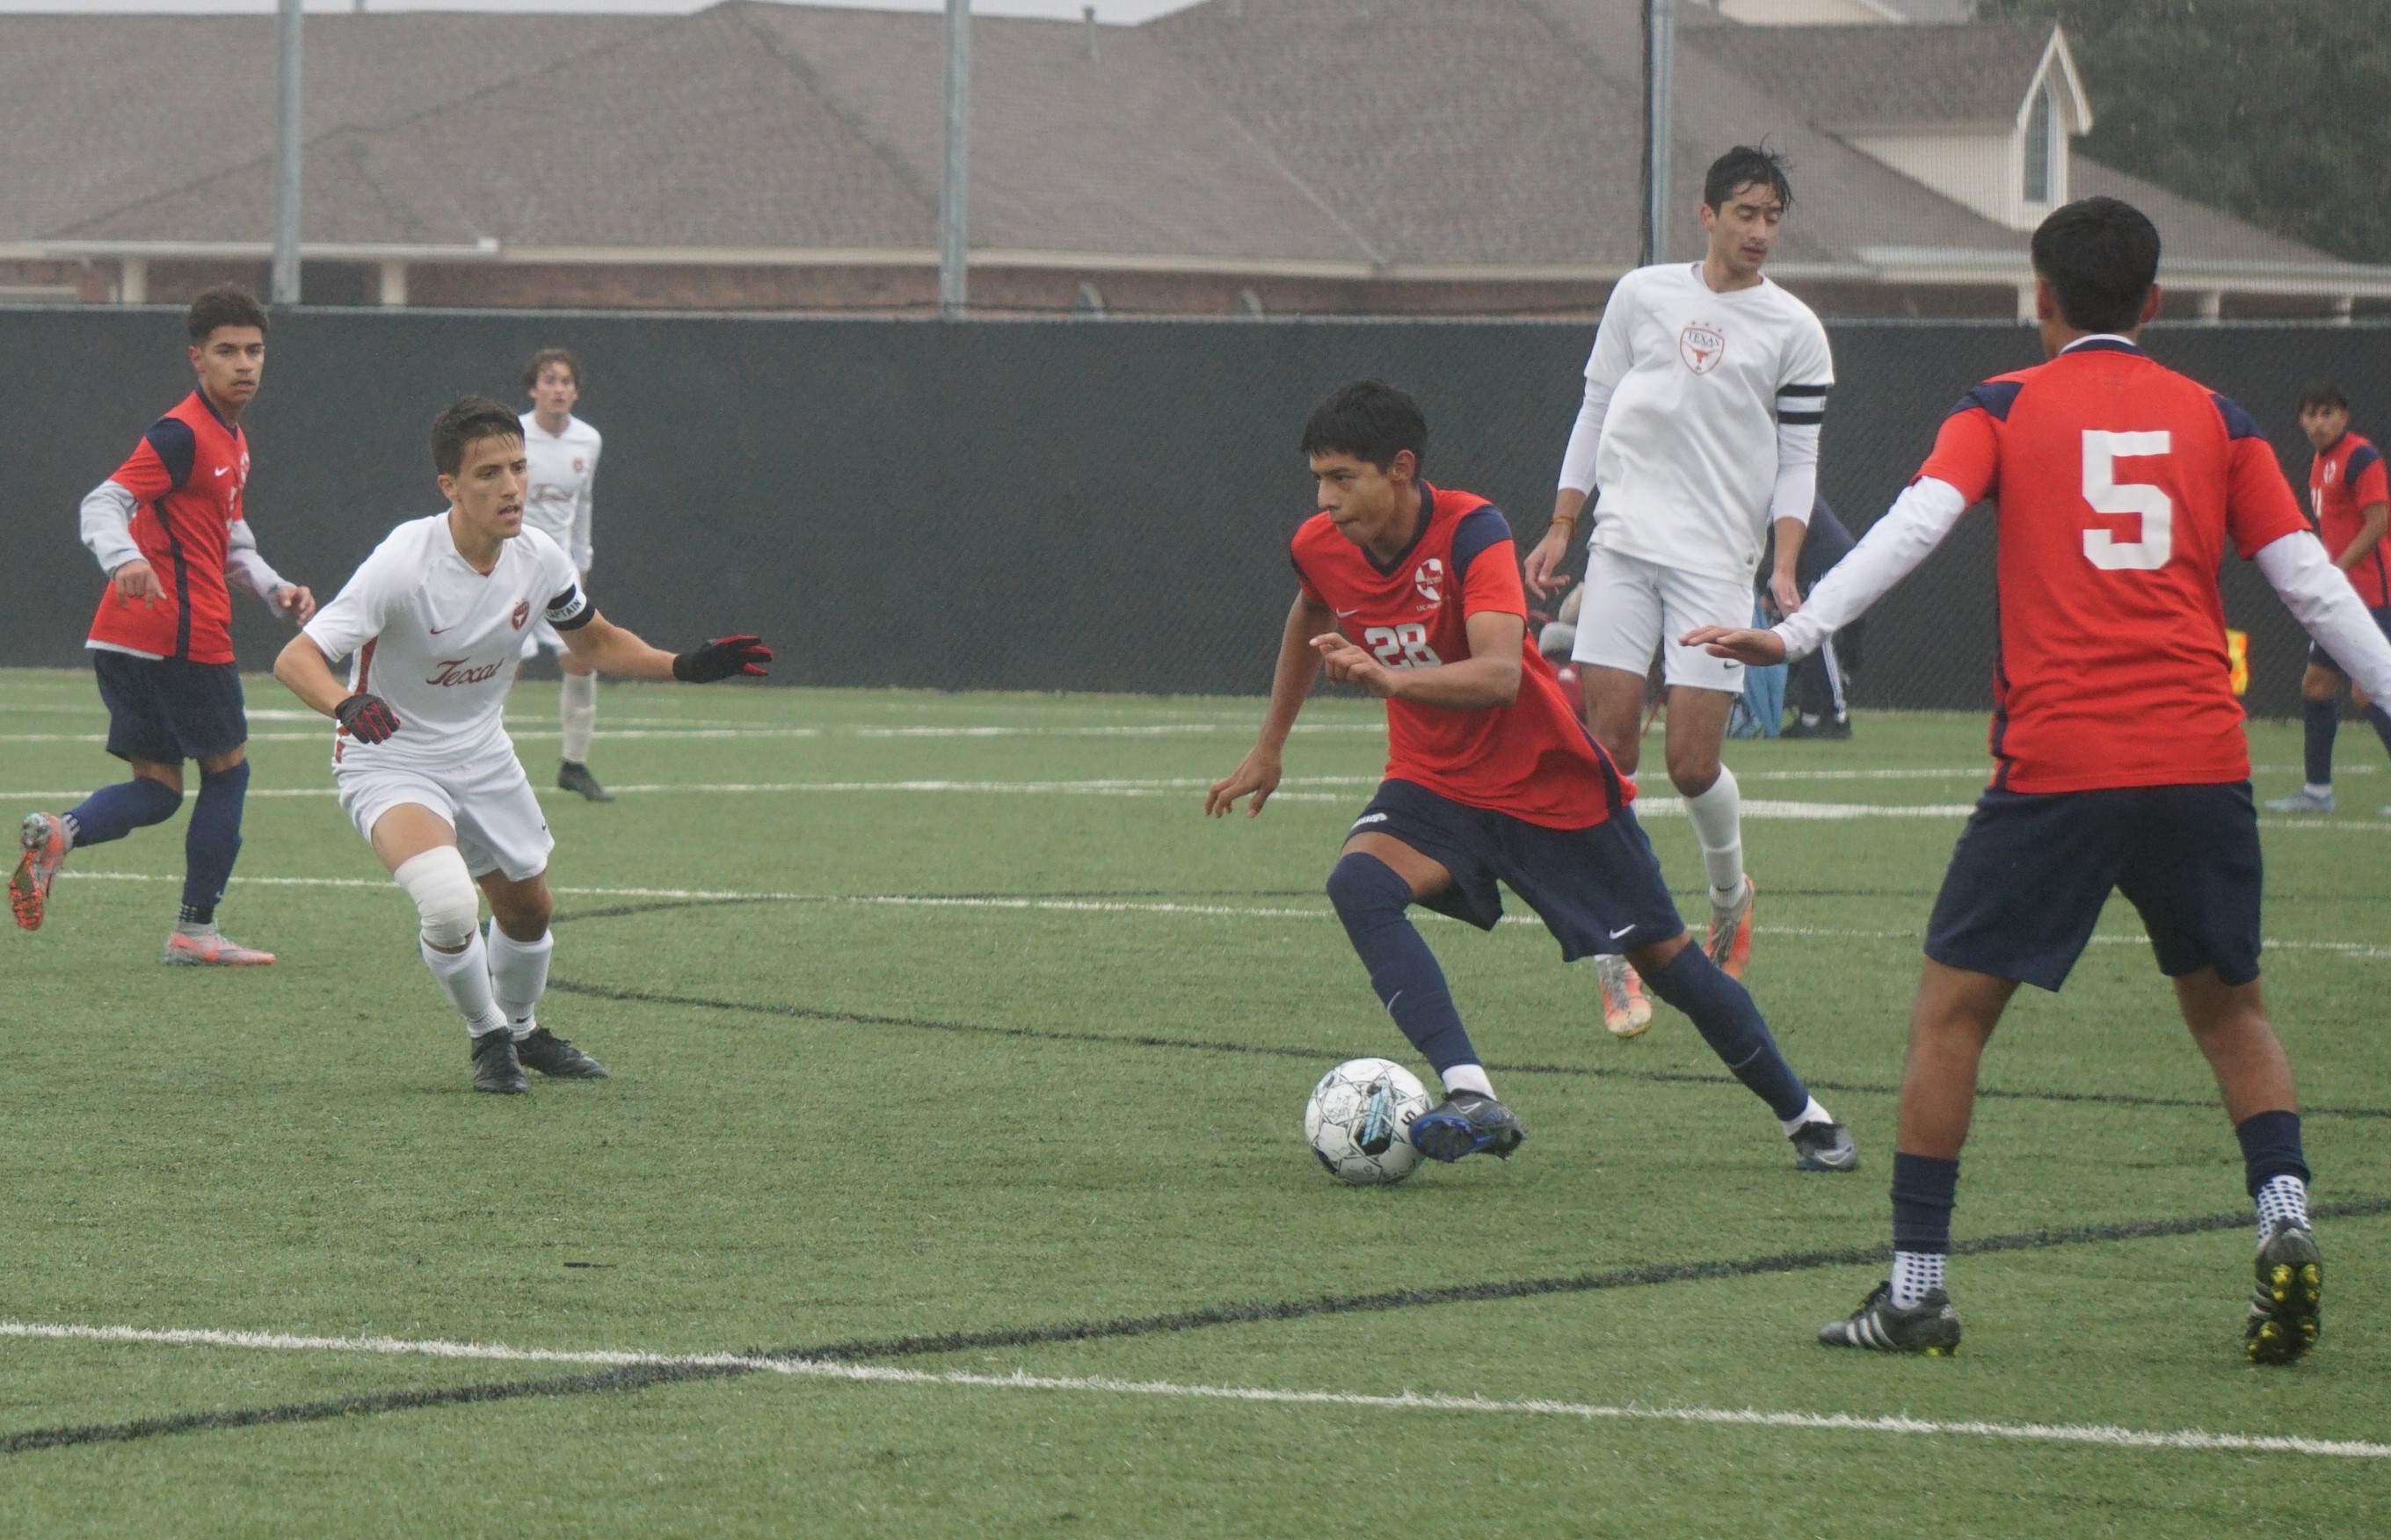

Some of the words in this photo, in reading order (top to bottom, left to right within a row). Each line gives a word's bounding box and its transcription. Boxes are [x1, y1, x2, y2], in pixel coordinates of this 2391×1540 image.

[1688, 331, 1720, 347] TEXAS
[2082, 429, 2171, 570] 5
[1364, 622, 1443, 669] 28
